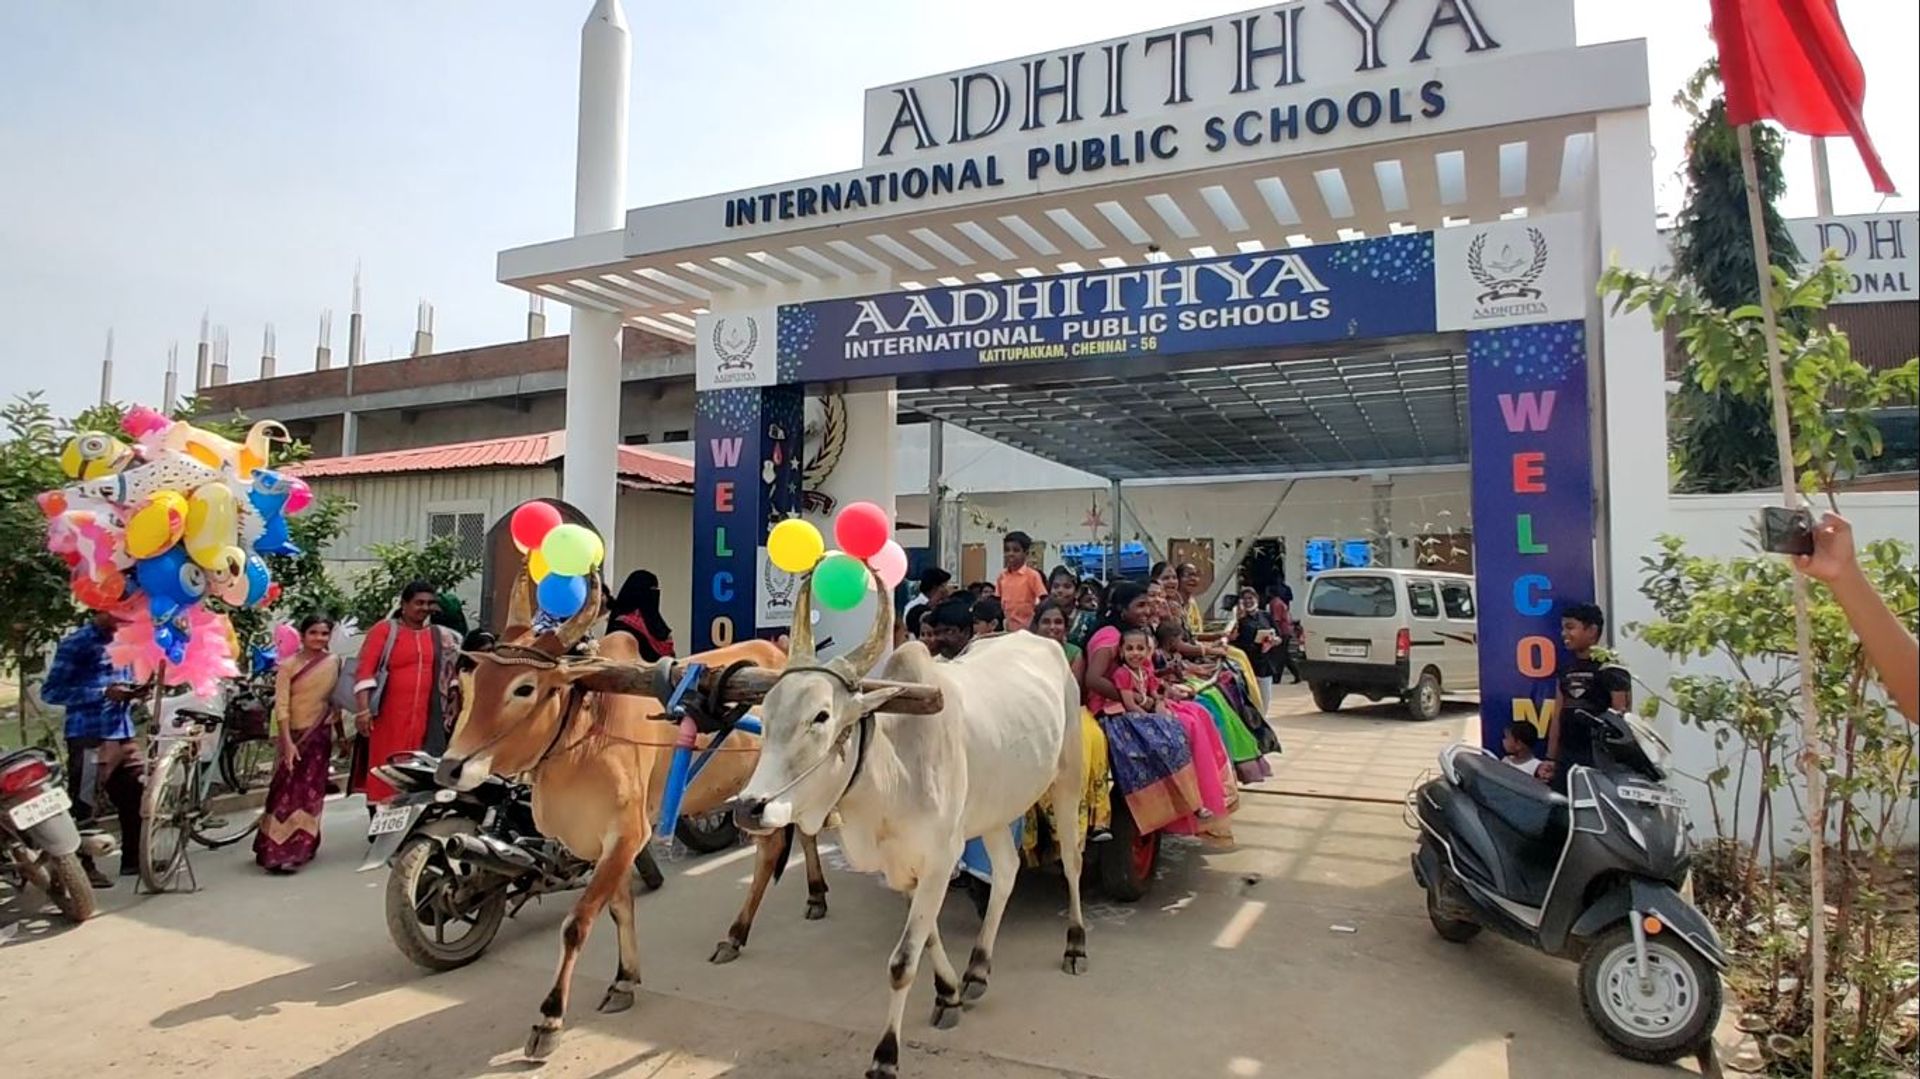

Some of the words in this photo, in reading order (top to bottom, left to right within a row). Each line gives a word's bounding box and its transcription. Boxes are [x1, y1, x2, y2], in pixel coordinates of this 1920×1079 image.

[878, 0, 1502, 156] ADHITHYA
[725, 155, 1004, 228] INTERNATIONAL
[1028, 124, 1180, 181] PUBLIC
[1204, 80, 1446, 153] SCHOOLS
[844, 325, 1045, 360] INTERNATIONAL
[1062, 312, 1168, 341] PUBLIC
[1178, 298, 1330, 331] SCHOOLS
[845, 254, 1330, 337] AADHITHYA
[978, 344, 1069, 364] KATTUPAKKAM,
[1071, 339, 1128, 357] CHENNAI
[1140, 337, 1157, 351] 56
[372, 818, 404, 833] 3106
